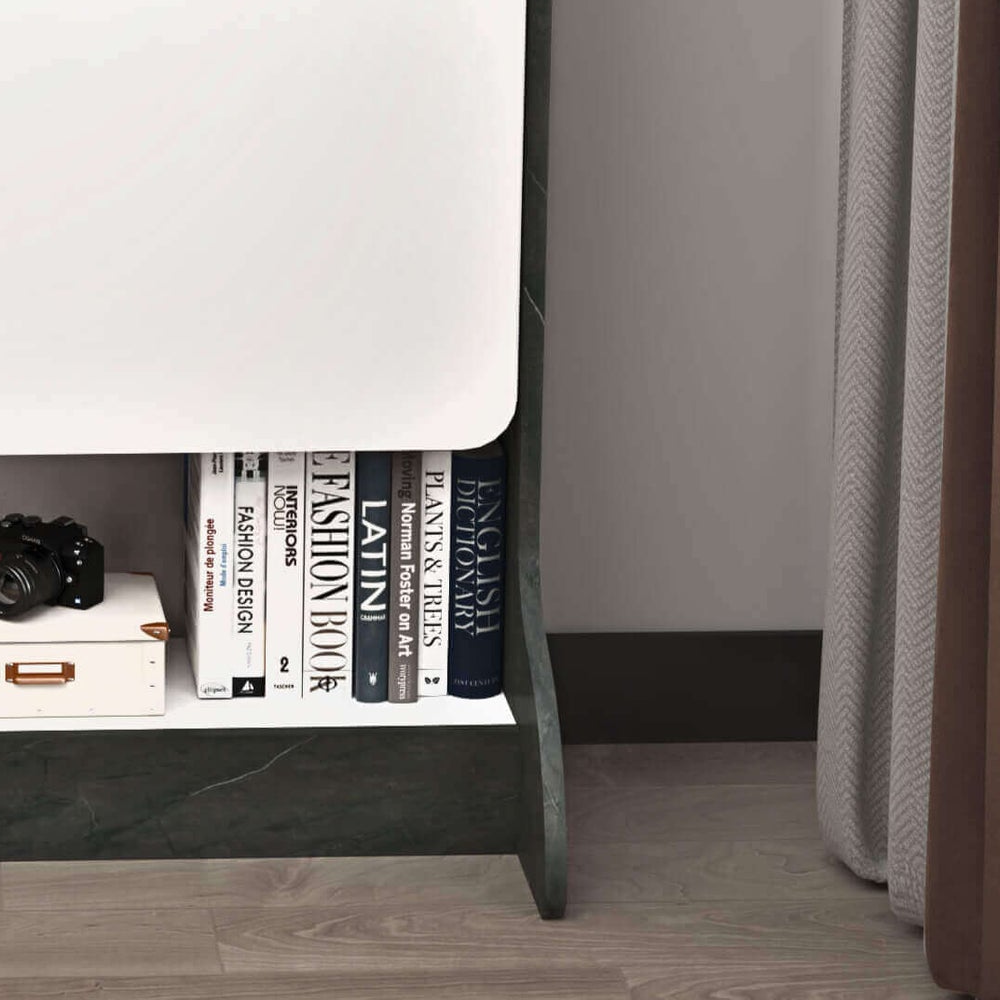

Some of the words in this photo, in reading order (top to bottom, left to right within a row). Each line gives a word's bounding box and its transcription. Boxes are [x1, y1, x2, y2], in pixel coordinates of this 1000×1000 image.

[205, 518, 217, 555] plongée
[237, 505, 254, 571] FASHION
[285, 485, 297, 567] INTERIORS
[310, 473, 350, 602] FASHION
[400, 502, 416, 561] Norman
[424, 471, 445, 553] PLANTS
[204, 557, 215, 569] de
[360, 500, 387, 612] LATIN
[454, 479, 476, 637] DICTIONARY
[475, 480, 502, 635] ENGLISH
[203, 571, 214, 612] Moniteur
[237, 578, 253, 634] DESIGN
[400, 565, 415, 610] Foster
[423, 579, 442, 648] TREES
[398, 633, 414, 658] Art
[399, 612, 411, 631] on
[280, 656, 289, 673] 2
